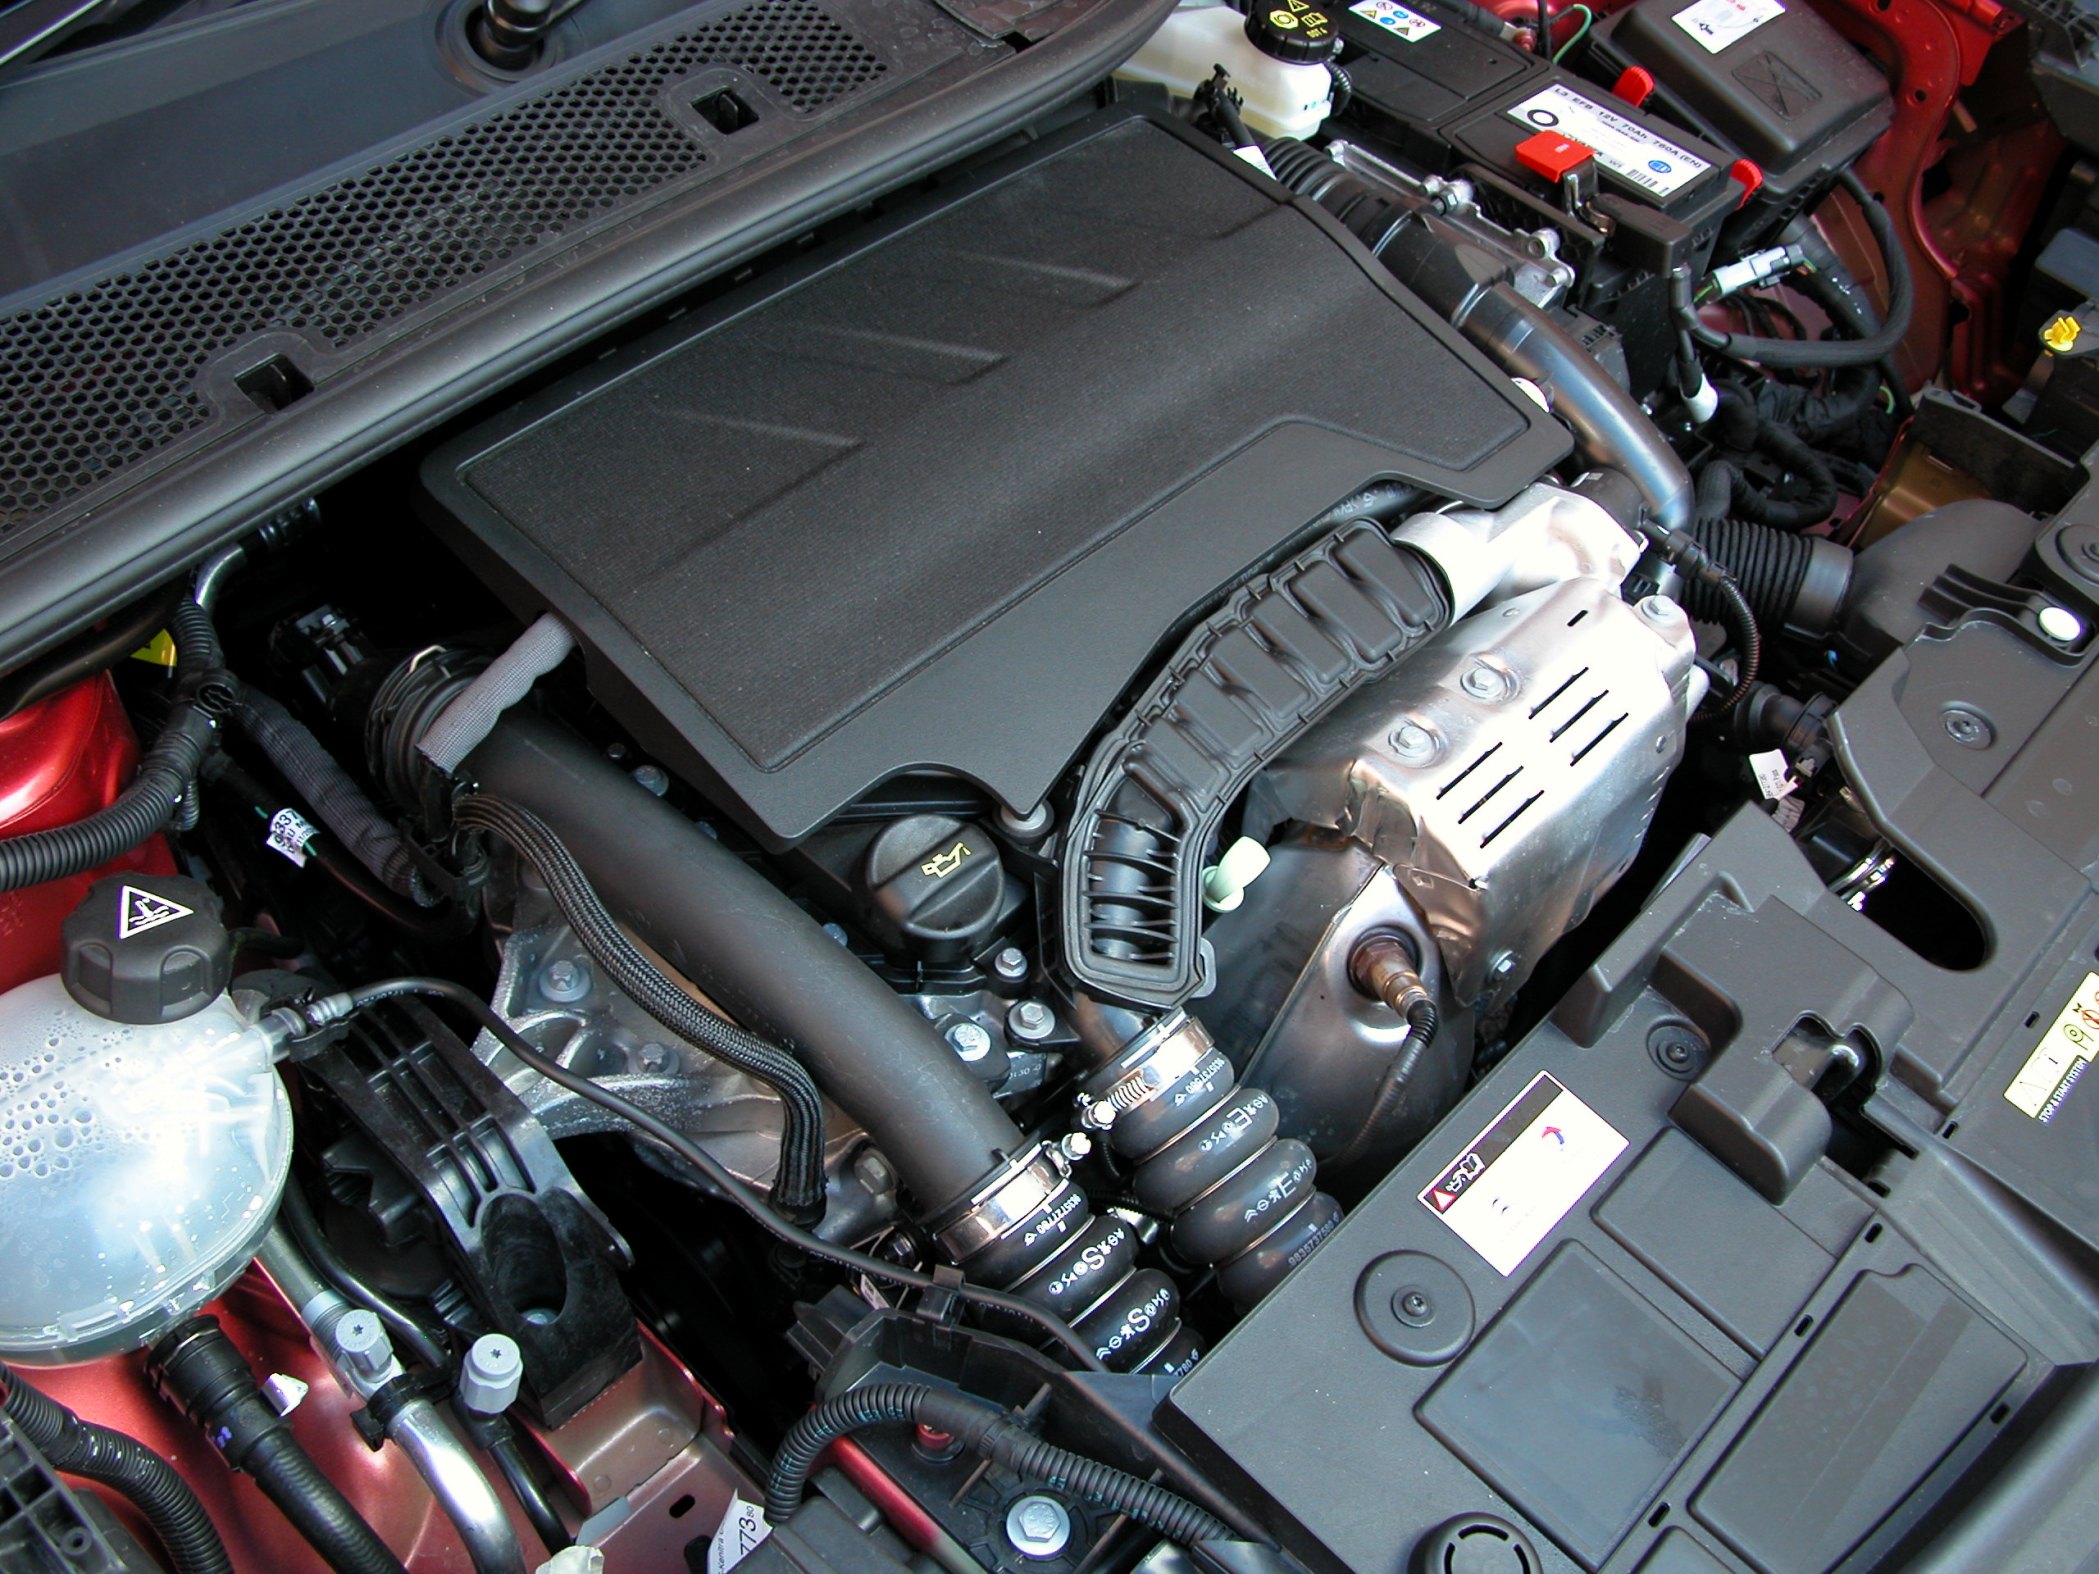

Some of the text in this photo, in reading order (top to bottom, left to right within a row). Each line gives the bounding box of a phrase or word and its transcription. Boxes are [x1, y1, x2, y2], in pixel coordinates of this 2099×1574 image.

[1572, 96, 1594, 110] EFB
[1597, 110, 1619, 123] 12V
[1621, 122, 1649, 140] 70Ah
[1679, 154, 1702, 170] (EN)
[2038, 1102, 2055, 1123] STOP
[2052, 1079, 2072, 1102] START
[2065, 1058, 2087, 1083] SYSTEM
